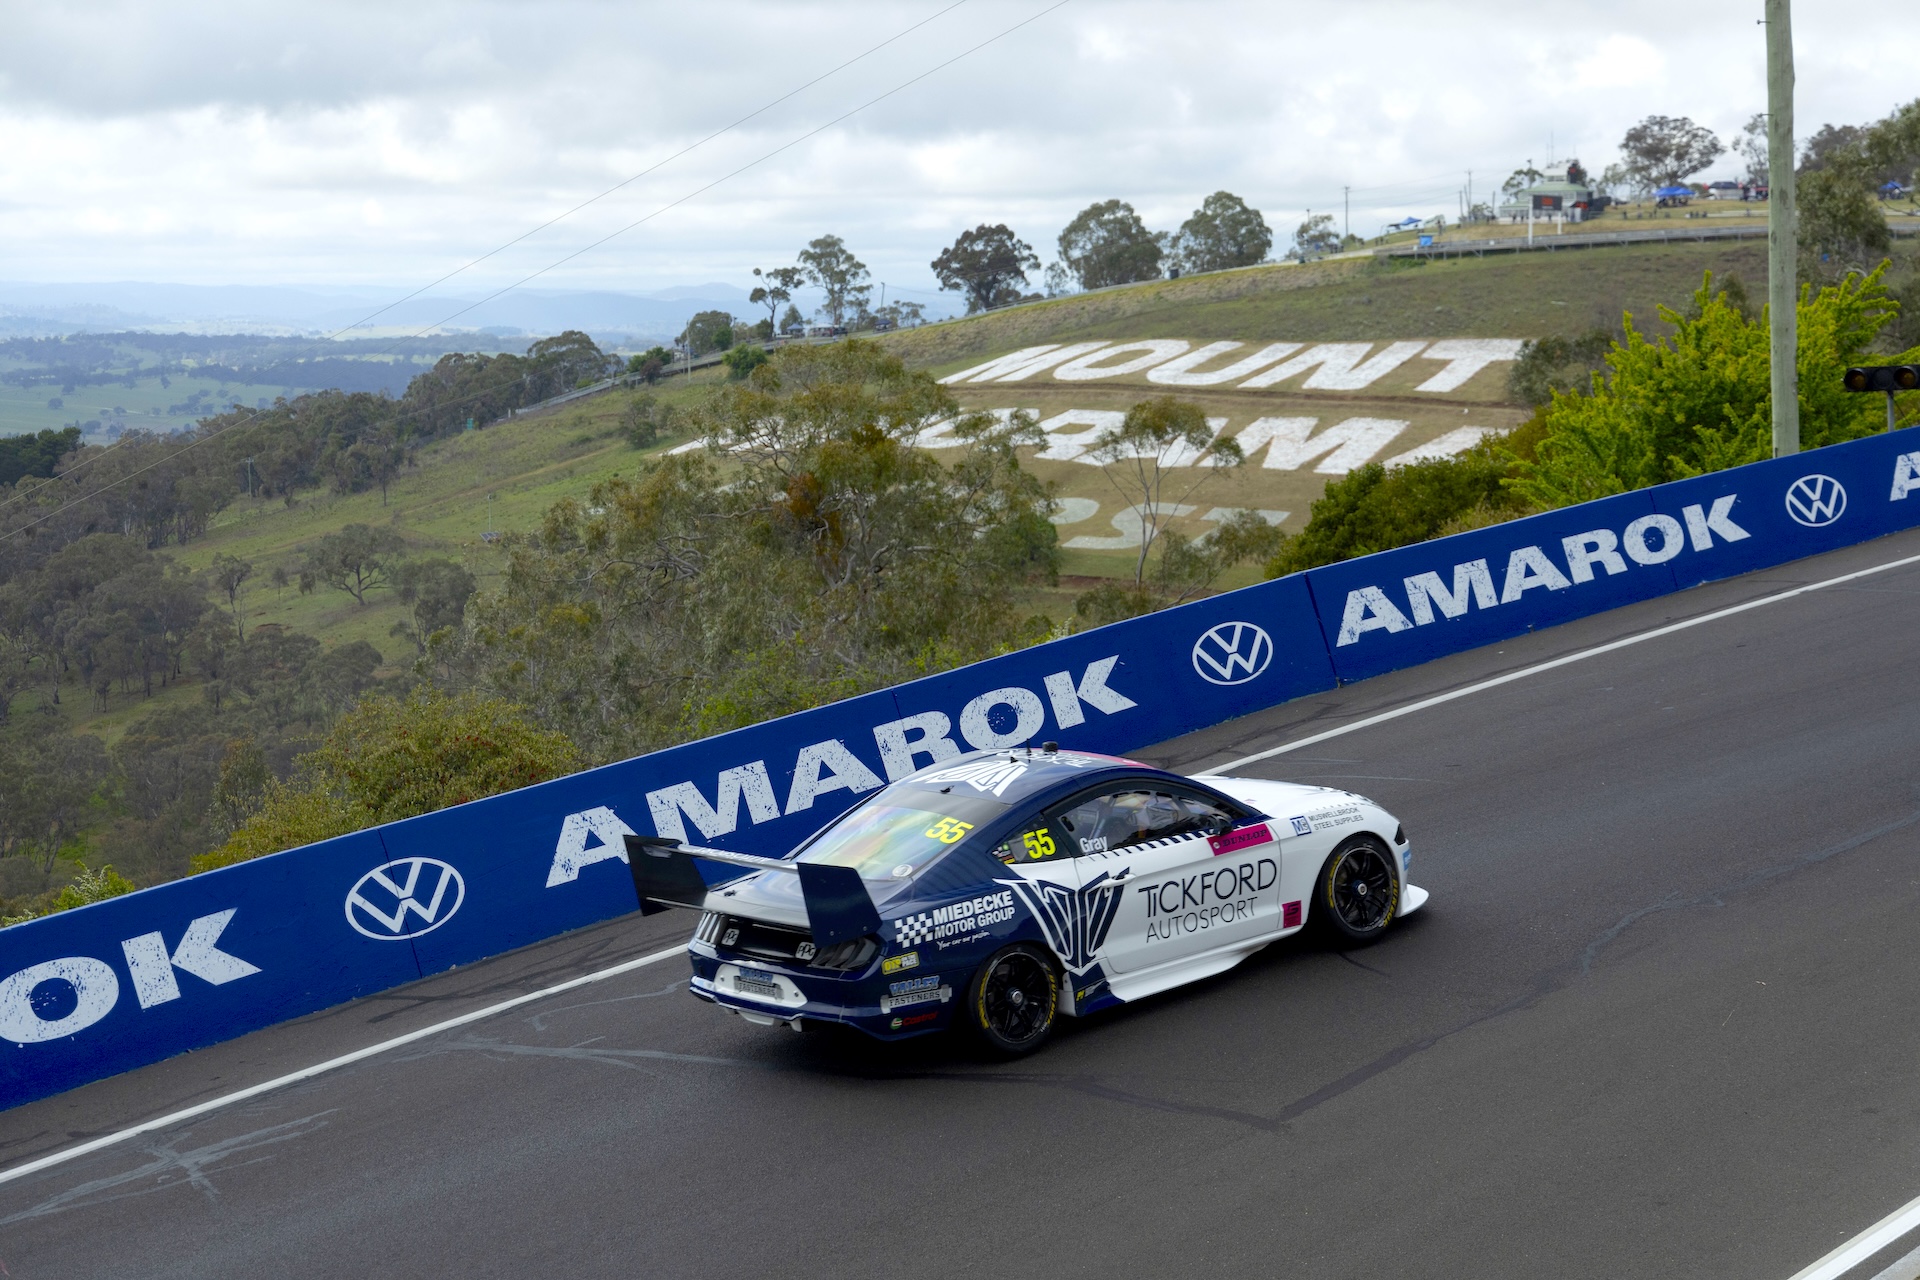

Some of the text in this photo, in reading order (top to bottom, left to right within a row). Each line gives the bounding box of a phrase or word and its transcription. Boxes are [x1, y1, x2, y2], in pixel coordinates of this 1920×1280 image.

[937, 337, 1525, 392] MOUNT
[1336, 493, 1751, 648] AMAROK
[545, 654, 1138, 888] AMAROK
[1308, 807, 1360, 822] MUSWELLBROOK
[1313, 815, 1364, 831] STEEL SUPPLIES
[925, 817, 974, 844] 55
[1023, 828, 1056, 859] 55
[1080, 836, 1108, 852] Gray
[1222, 829, 1268, 847] DUNLOP
[1138, 858, 1277, 918] TICKFORD
[932, 890, 1014, 926] MIEDECKE
[934, 907, 1016, 940] MOTOR GROUP
[1146, 897, 1258, 943] AUTOSPORT
[0, 906, 263, 1044] OK
[889, 975, 941, 995] VALLEY
[889, 990, 942, 1007] FASTENERS
[902, 1012, 938, 1026] Castrol
